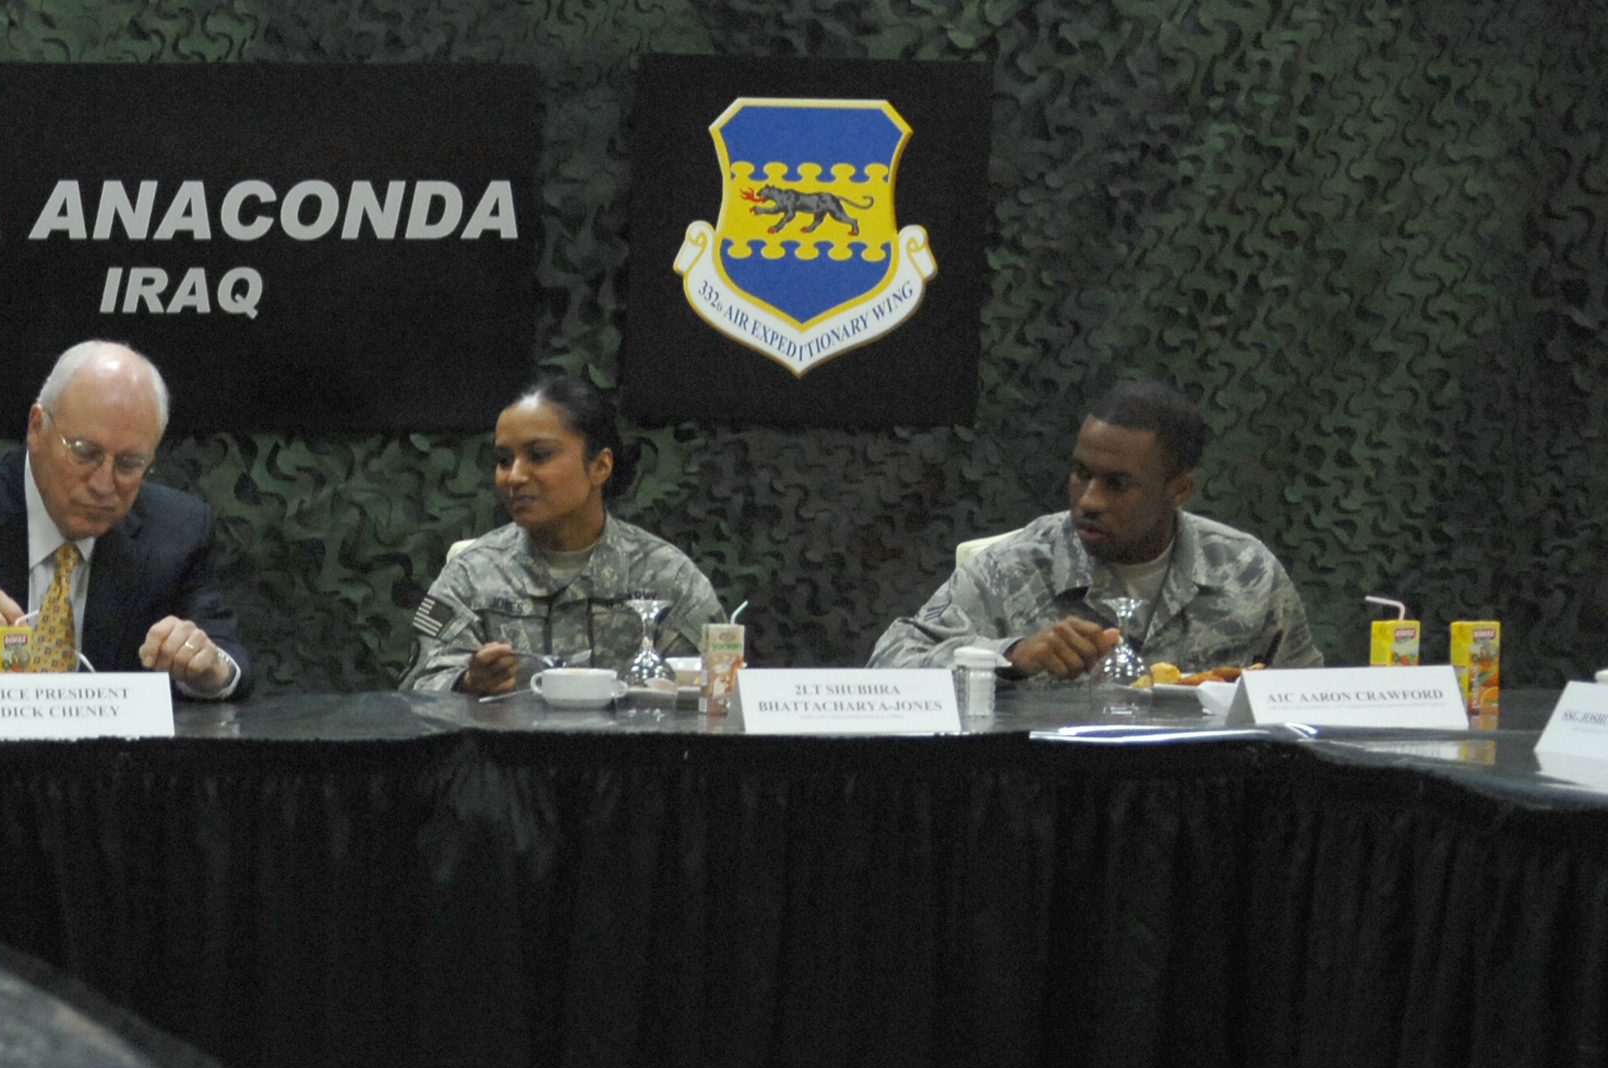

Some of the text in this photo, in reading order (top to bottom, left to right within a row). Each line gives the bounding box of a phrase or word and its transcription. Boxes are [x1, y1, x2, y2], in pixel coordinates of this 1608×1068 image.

[29, 178, 520, 240] ANACONDA
[100, 267, 264, 319] IRAQ
[724, 305, 749, 331] AIR
[751, 312, 869, 361] EXPEDITIONARY
[872, 281, 914, 321] WING
[35, 687, 129, 700] PRESIDENT
[794, 684, 901, 696] 2LT SHUBHRA
[1298, 691, 1352, 703] AARON
[1355, 689, 1444, 702] CRAWFORD
[1, 705, 120, 718] DICK CHENEY
[758, 701, 943, 713] BHATTACHARYA-JONES
